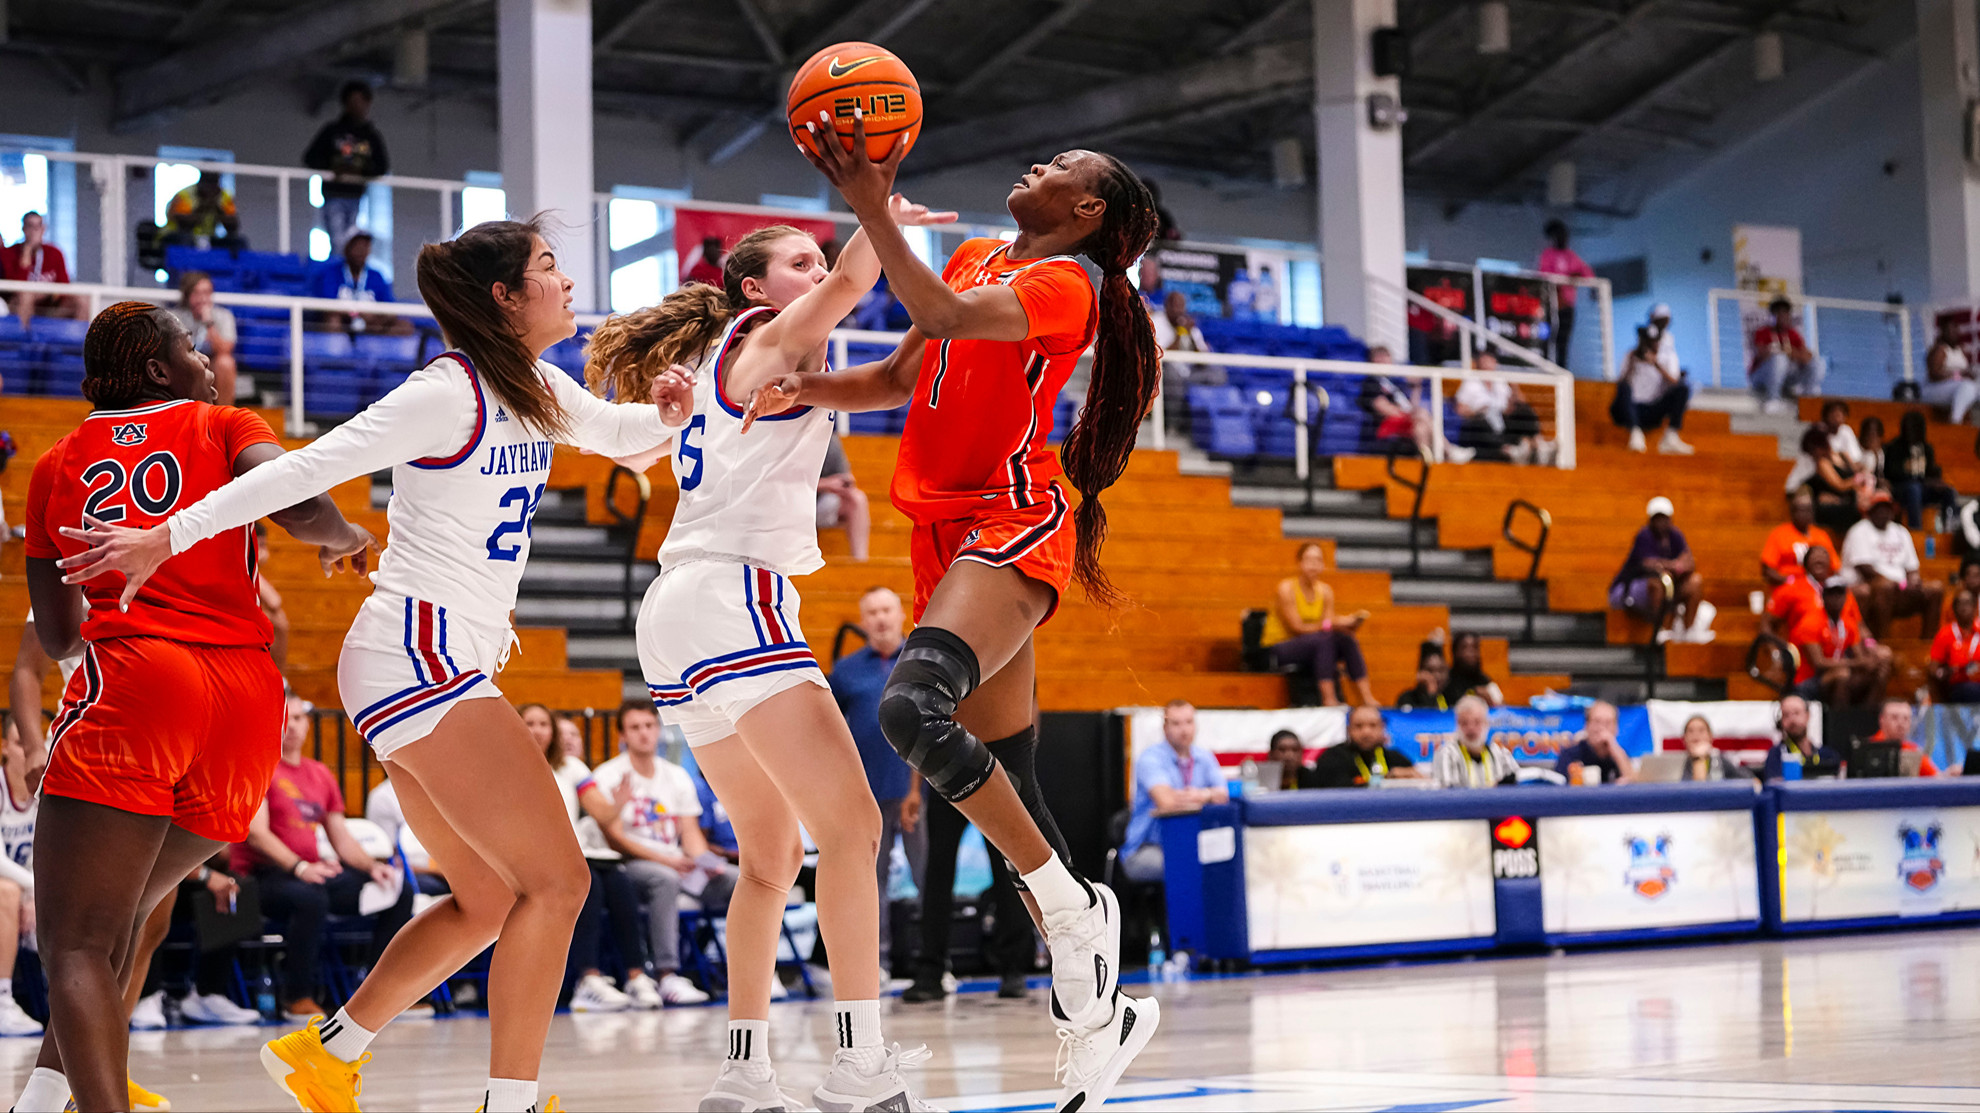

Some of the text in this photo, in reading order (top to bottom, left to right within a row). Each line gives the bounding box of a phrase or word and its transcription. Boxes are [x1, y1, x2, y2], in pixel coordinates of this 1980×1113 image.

[834, 93, 906, 118] ELITE
[835, 113, 907, 126] CHAPIONSHIP
[480, 440, 555, 475] JAYHAW
[80, 450, 182, 532] 20
[1493, 848, 1538, 878] POSS
